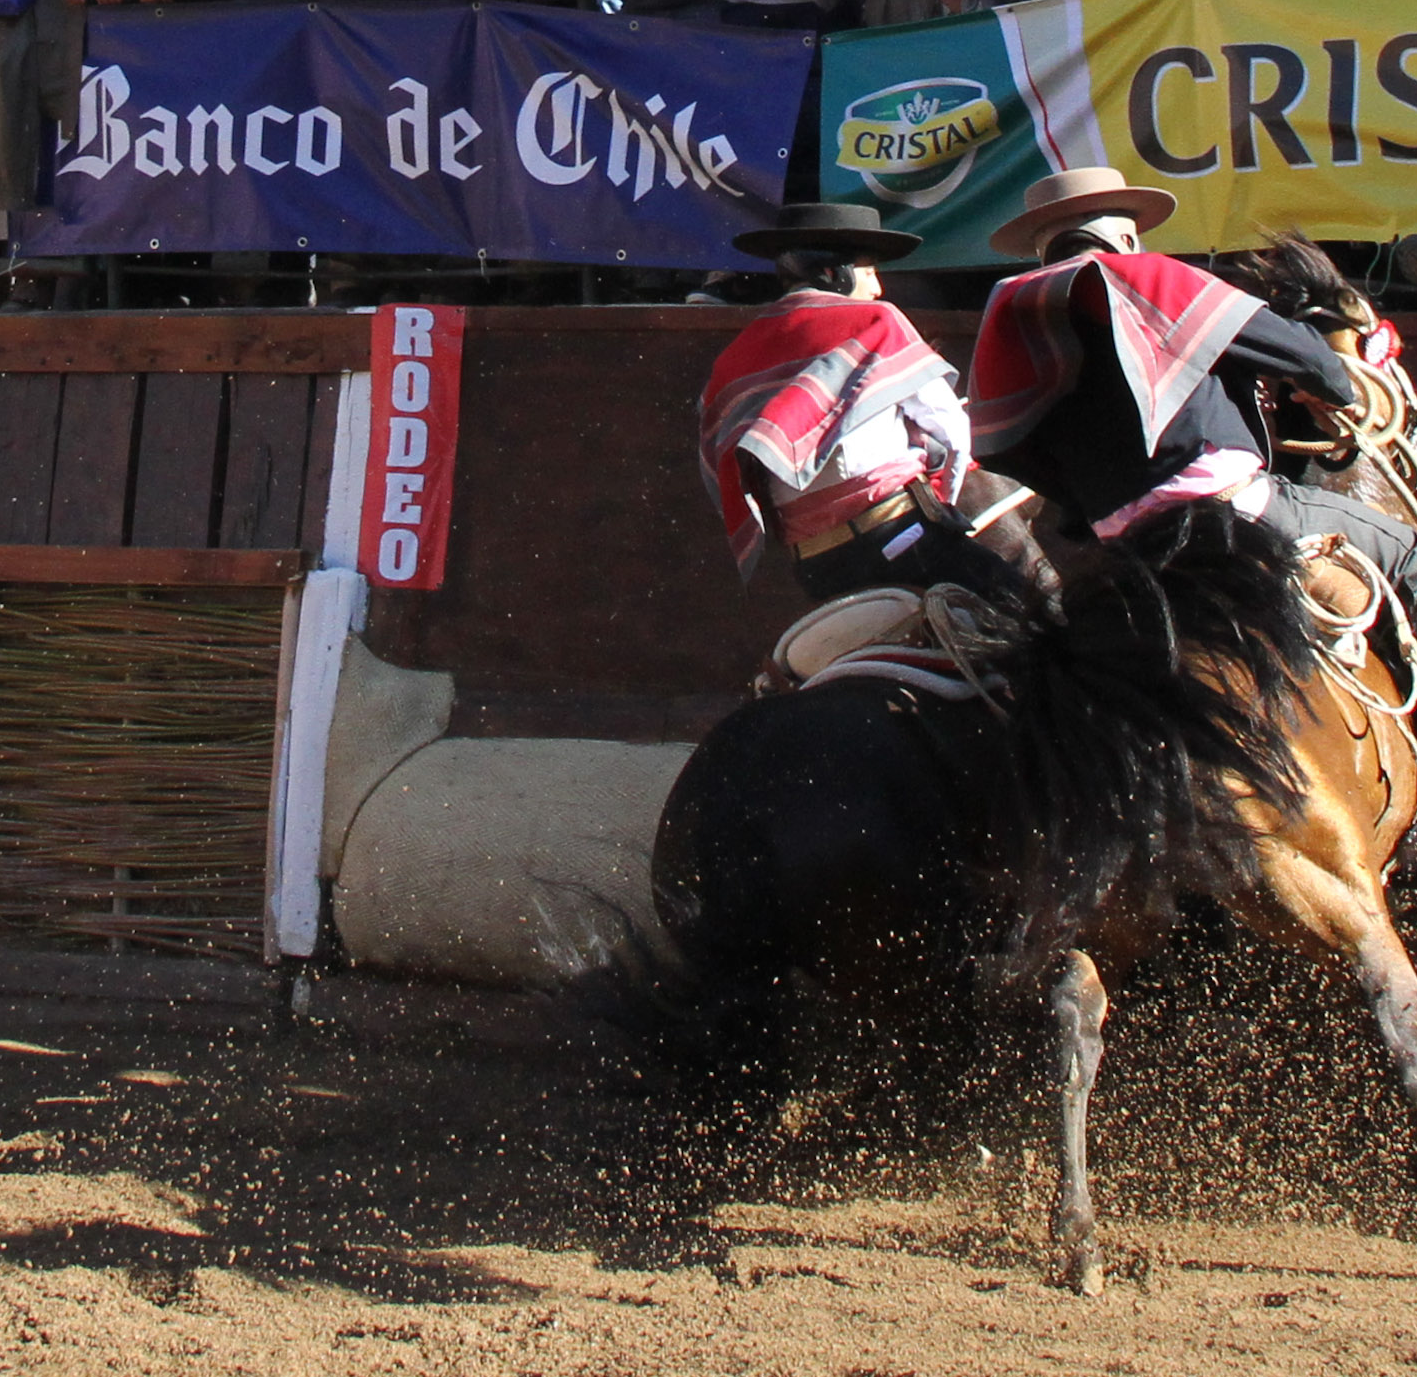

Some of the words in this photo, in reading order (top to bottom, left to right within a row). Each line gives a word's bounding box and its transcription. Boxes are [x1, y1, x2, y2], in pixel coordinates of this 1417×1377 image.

[55, 63, 343, 180] Banco
[388, 76, 484, 180] de
[515, 70, 745, 202] Chile
[854, 116, 989, 160] CRISTAL
[378, 306, 434, 581] RODEO
